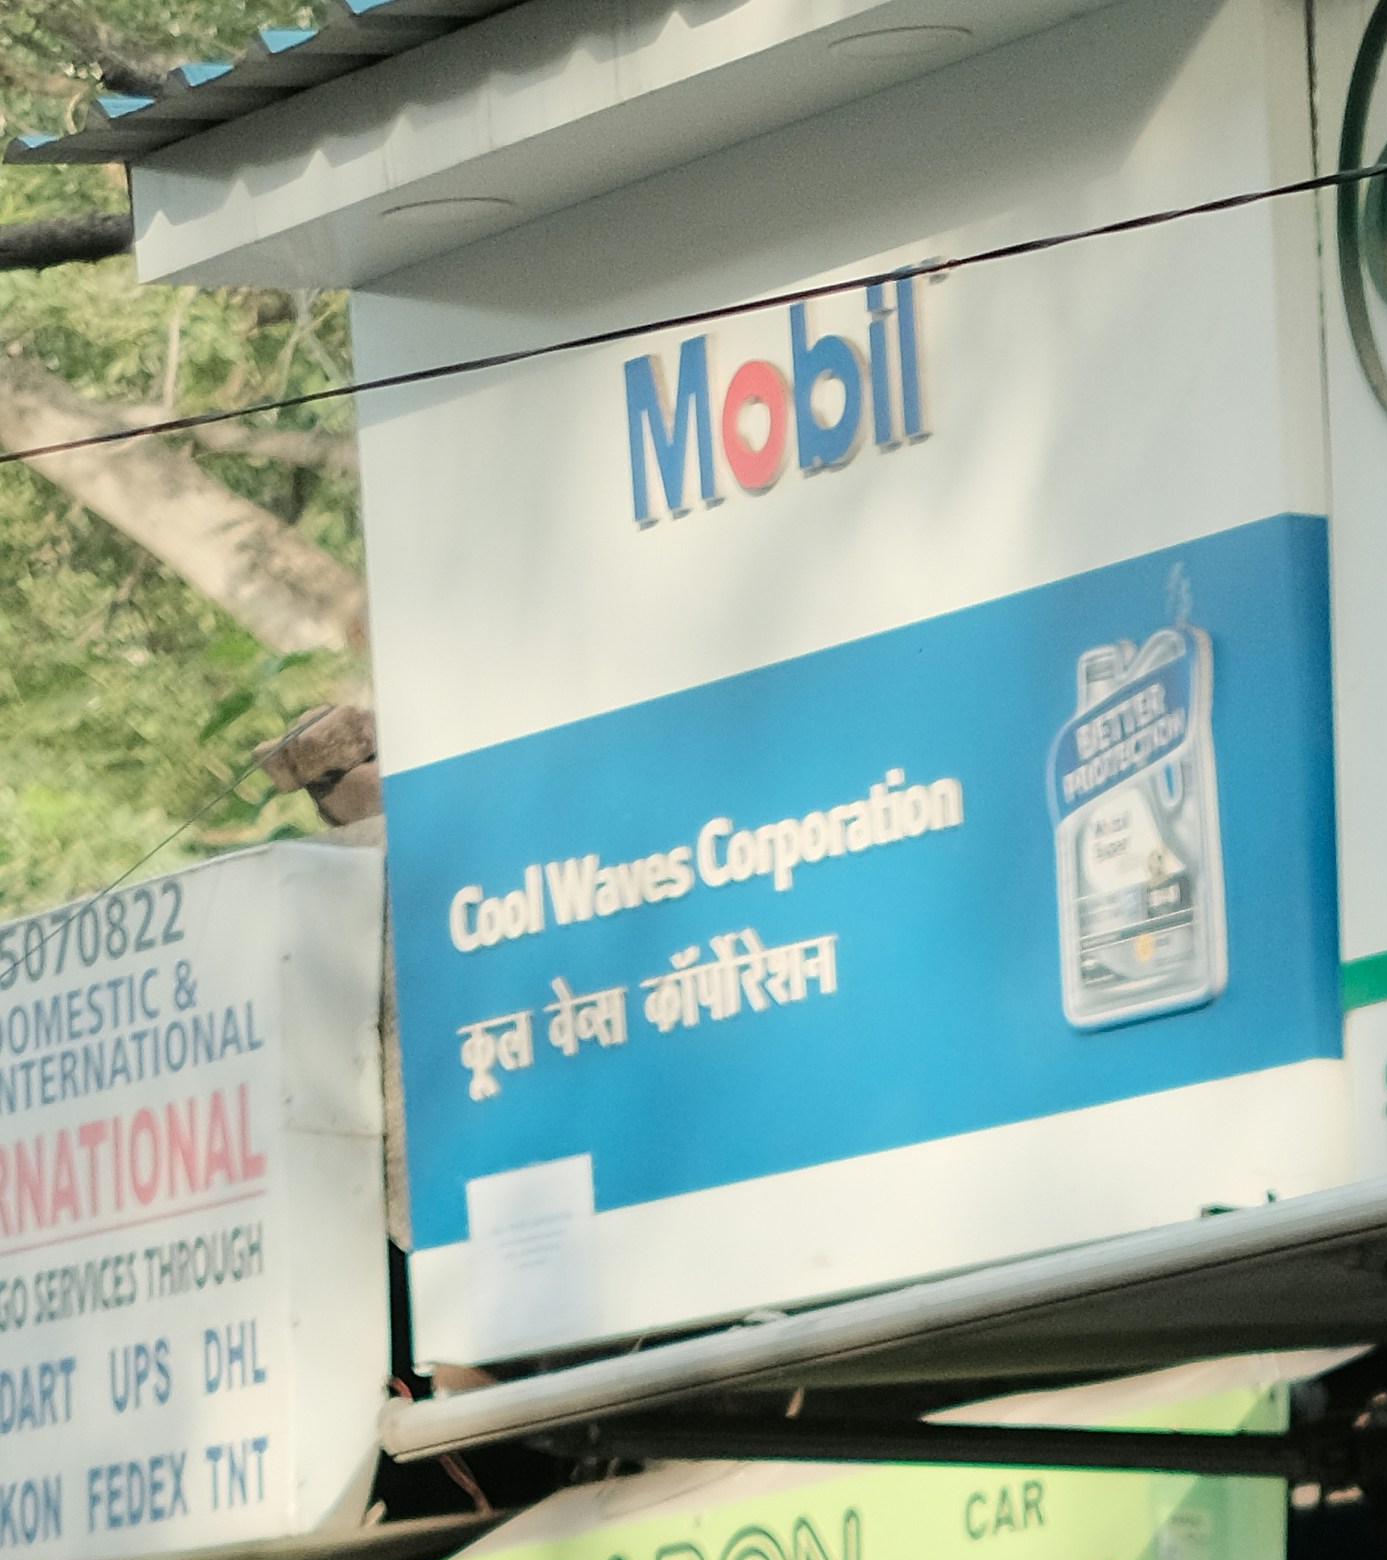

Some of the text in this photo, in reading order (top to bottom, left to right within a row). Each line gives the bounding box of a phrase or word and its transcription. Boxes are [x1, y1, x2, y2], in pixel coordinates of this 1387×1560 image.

[624, 266, 925, 525] Mobil
[449, 768, 964, 952] Cool Waves Corporation
[0, 959, 198, 1055] OMESTIC &
[34, 1252, 137, 1326] SERVICES
[144, 1220, 265, 1298] THROUGH
[109, 1336, 172, 1414] UPS
[203, 1318, 267, 1396] DHL
[87, 1450, 189, 1535] FEDEX
[205, 1435, 269, 1511] TNT
[964, 1479, 1046, 1541] CAR
